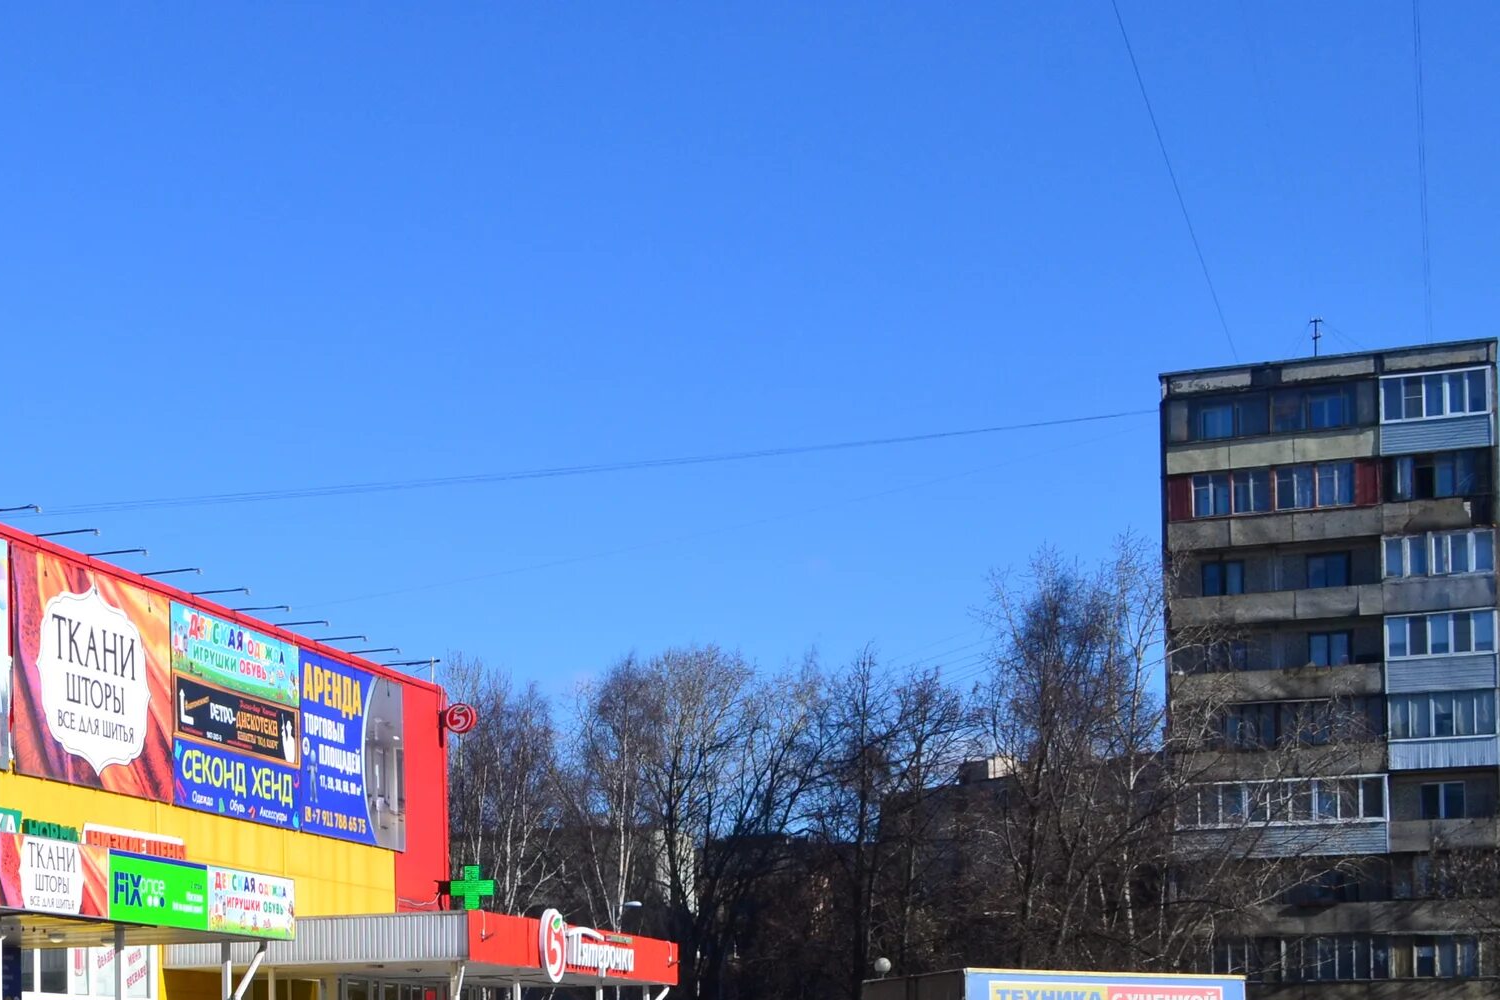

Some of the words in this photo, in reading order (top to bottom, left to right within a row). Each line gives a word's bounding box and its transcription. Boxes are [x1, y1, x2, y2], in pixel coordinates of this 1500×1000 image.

[52, 613, 137, 681] ТКАНИ
[188, 613, 244, 652] ДЕТСКАЯ
[192, 645, 238, 673] ИГРУШКИ
[239, 659, 267, 681] ОБУВЬ
[66, 671, 126, 716] ШТОРЫ
[303, 661, 363, 721] АРЕНДА
[57, 709, 76, 731] ВСЕ
[78, 715, 100, 736] ДЛЯ
[102, 720, 136, 745] ШИТЬЯ
[303, 711, 346, 745] ТОРГОВЫХ
[318, 743, 361, 777] ПЛОЩАДЕЙ
[182, 748, 247, 799] СЕКОНД
[251, 765, 293, 809] ХЕНД
[191, 789, 214, 808] Одежда
[229, 798, 246, 816] Обувь
[27, 841, 77, 874] ТКАНИ
[34, 873, 71, 895] ШТОРЫ
[214, 871, 256, 894] ДЕТСКАЯ
[29, 895, 40, 906] ВСЕ
[41, 896, 55, 908] ДЛЯ
[226, 896, 261, 911] ИГРУШКИ
[263, 901, 284, 915] ОБУВЬ
